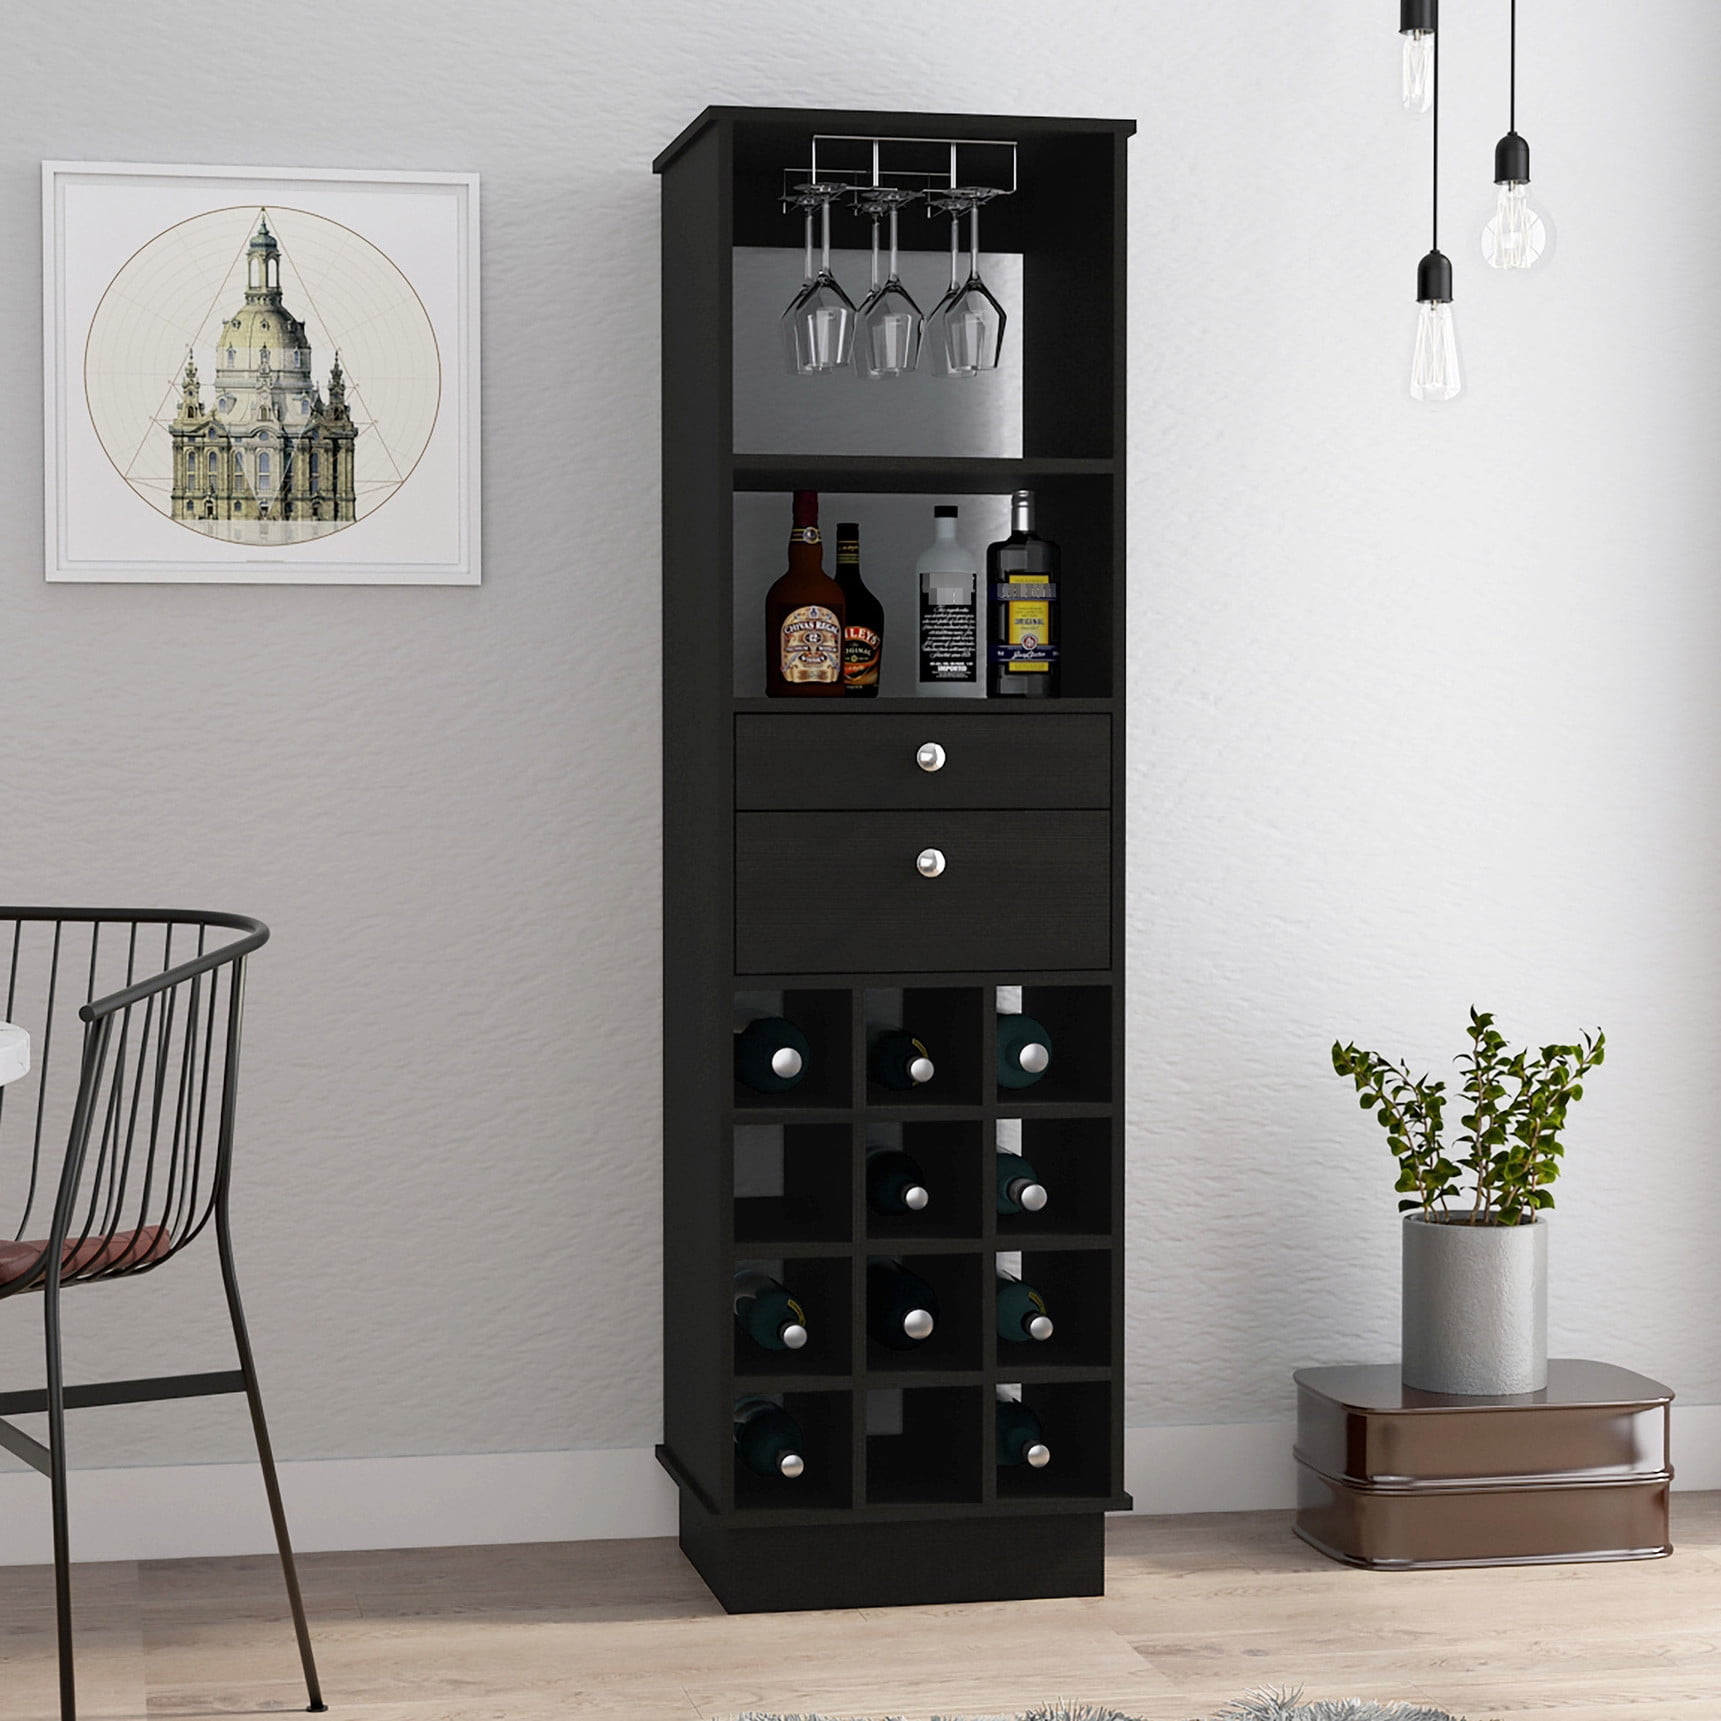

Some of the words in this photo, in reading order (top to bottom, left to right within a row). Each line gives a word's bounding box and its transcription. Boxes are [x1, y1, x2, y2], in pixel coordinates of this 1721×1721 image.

[784, 621, 815, 634] CHIVAS
[816, 621, 839, 634] REGAL
[844, 628, 877, 645] ILEYS
[845, 648, 872, 656] IGINAL
